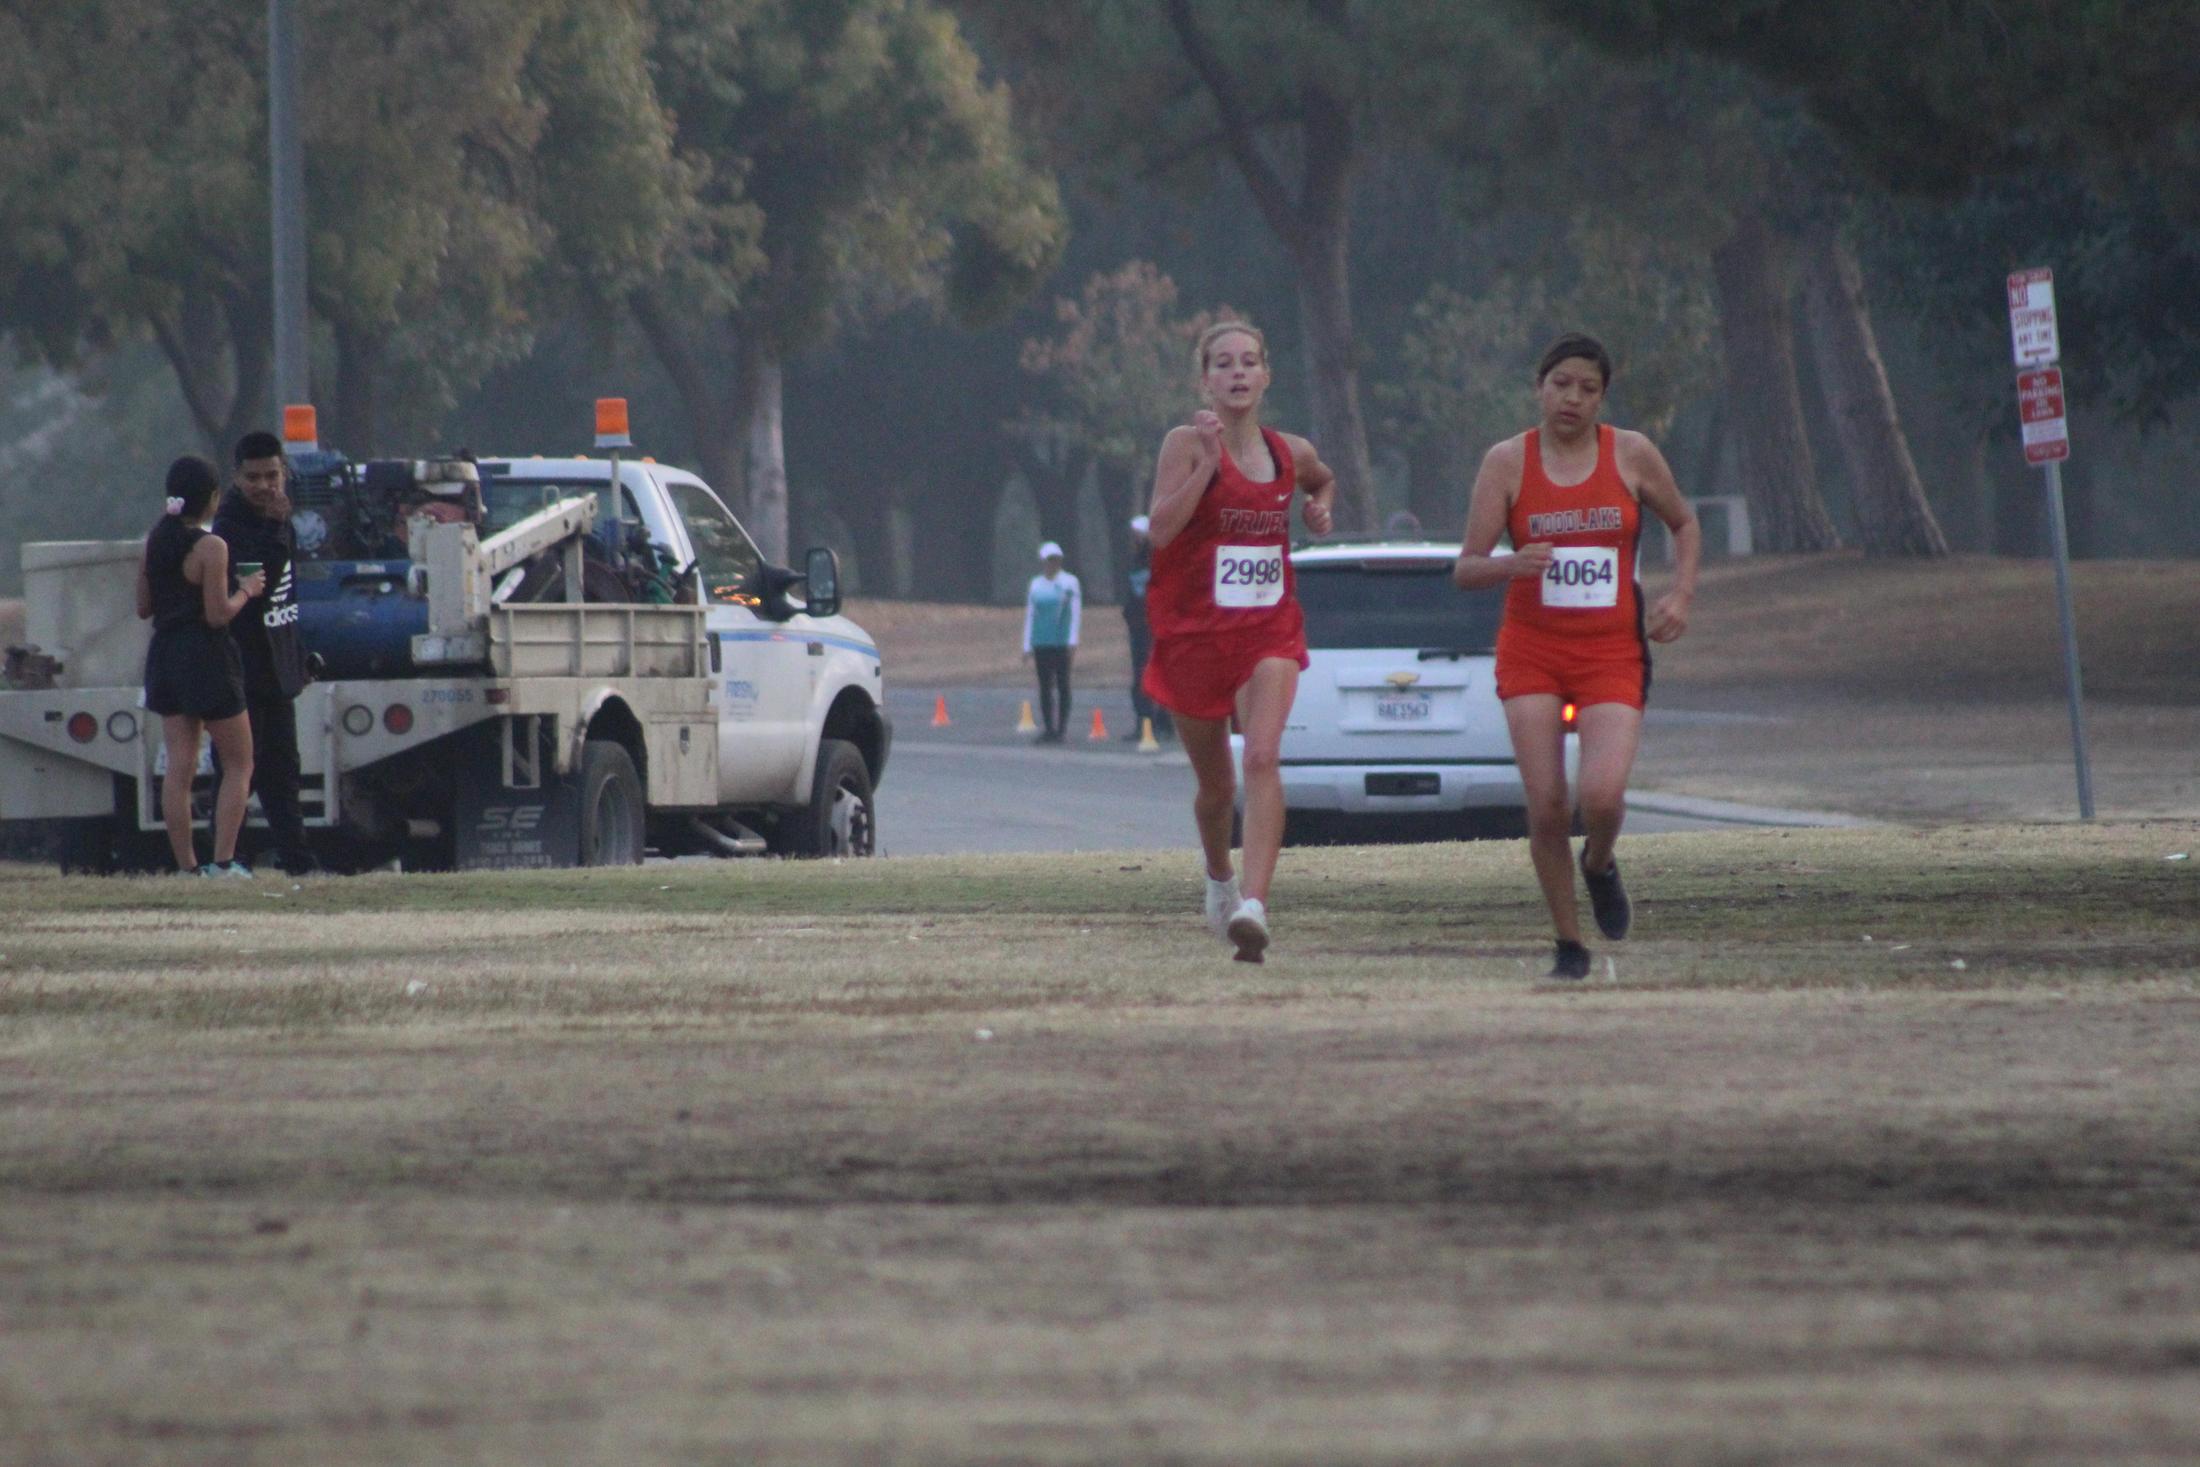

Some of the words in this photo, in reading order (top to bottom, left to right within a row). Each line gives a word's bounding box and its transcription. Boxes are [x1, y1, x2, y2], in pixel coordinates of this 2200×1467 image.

[2011, 286, 2027, 307] NO
[2014, 309, 2053, 328] STOPPING
[2018, 333, 2032, 347] ANY
[2036, 330, 2052, 344] TIME
[2033, 374, 2047, 387] NO
[2021, 387, 2060, 400] PARKING
[1528, 506, 1622, 537] WOODLAKE
[1220, 558, 1281, 585] 2998
[1547, 558, 1612, 586] 4064
[475, 805, 546, 830] SE
